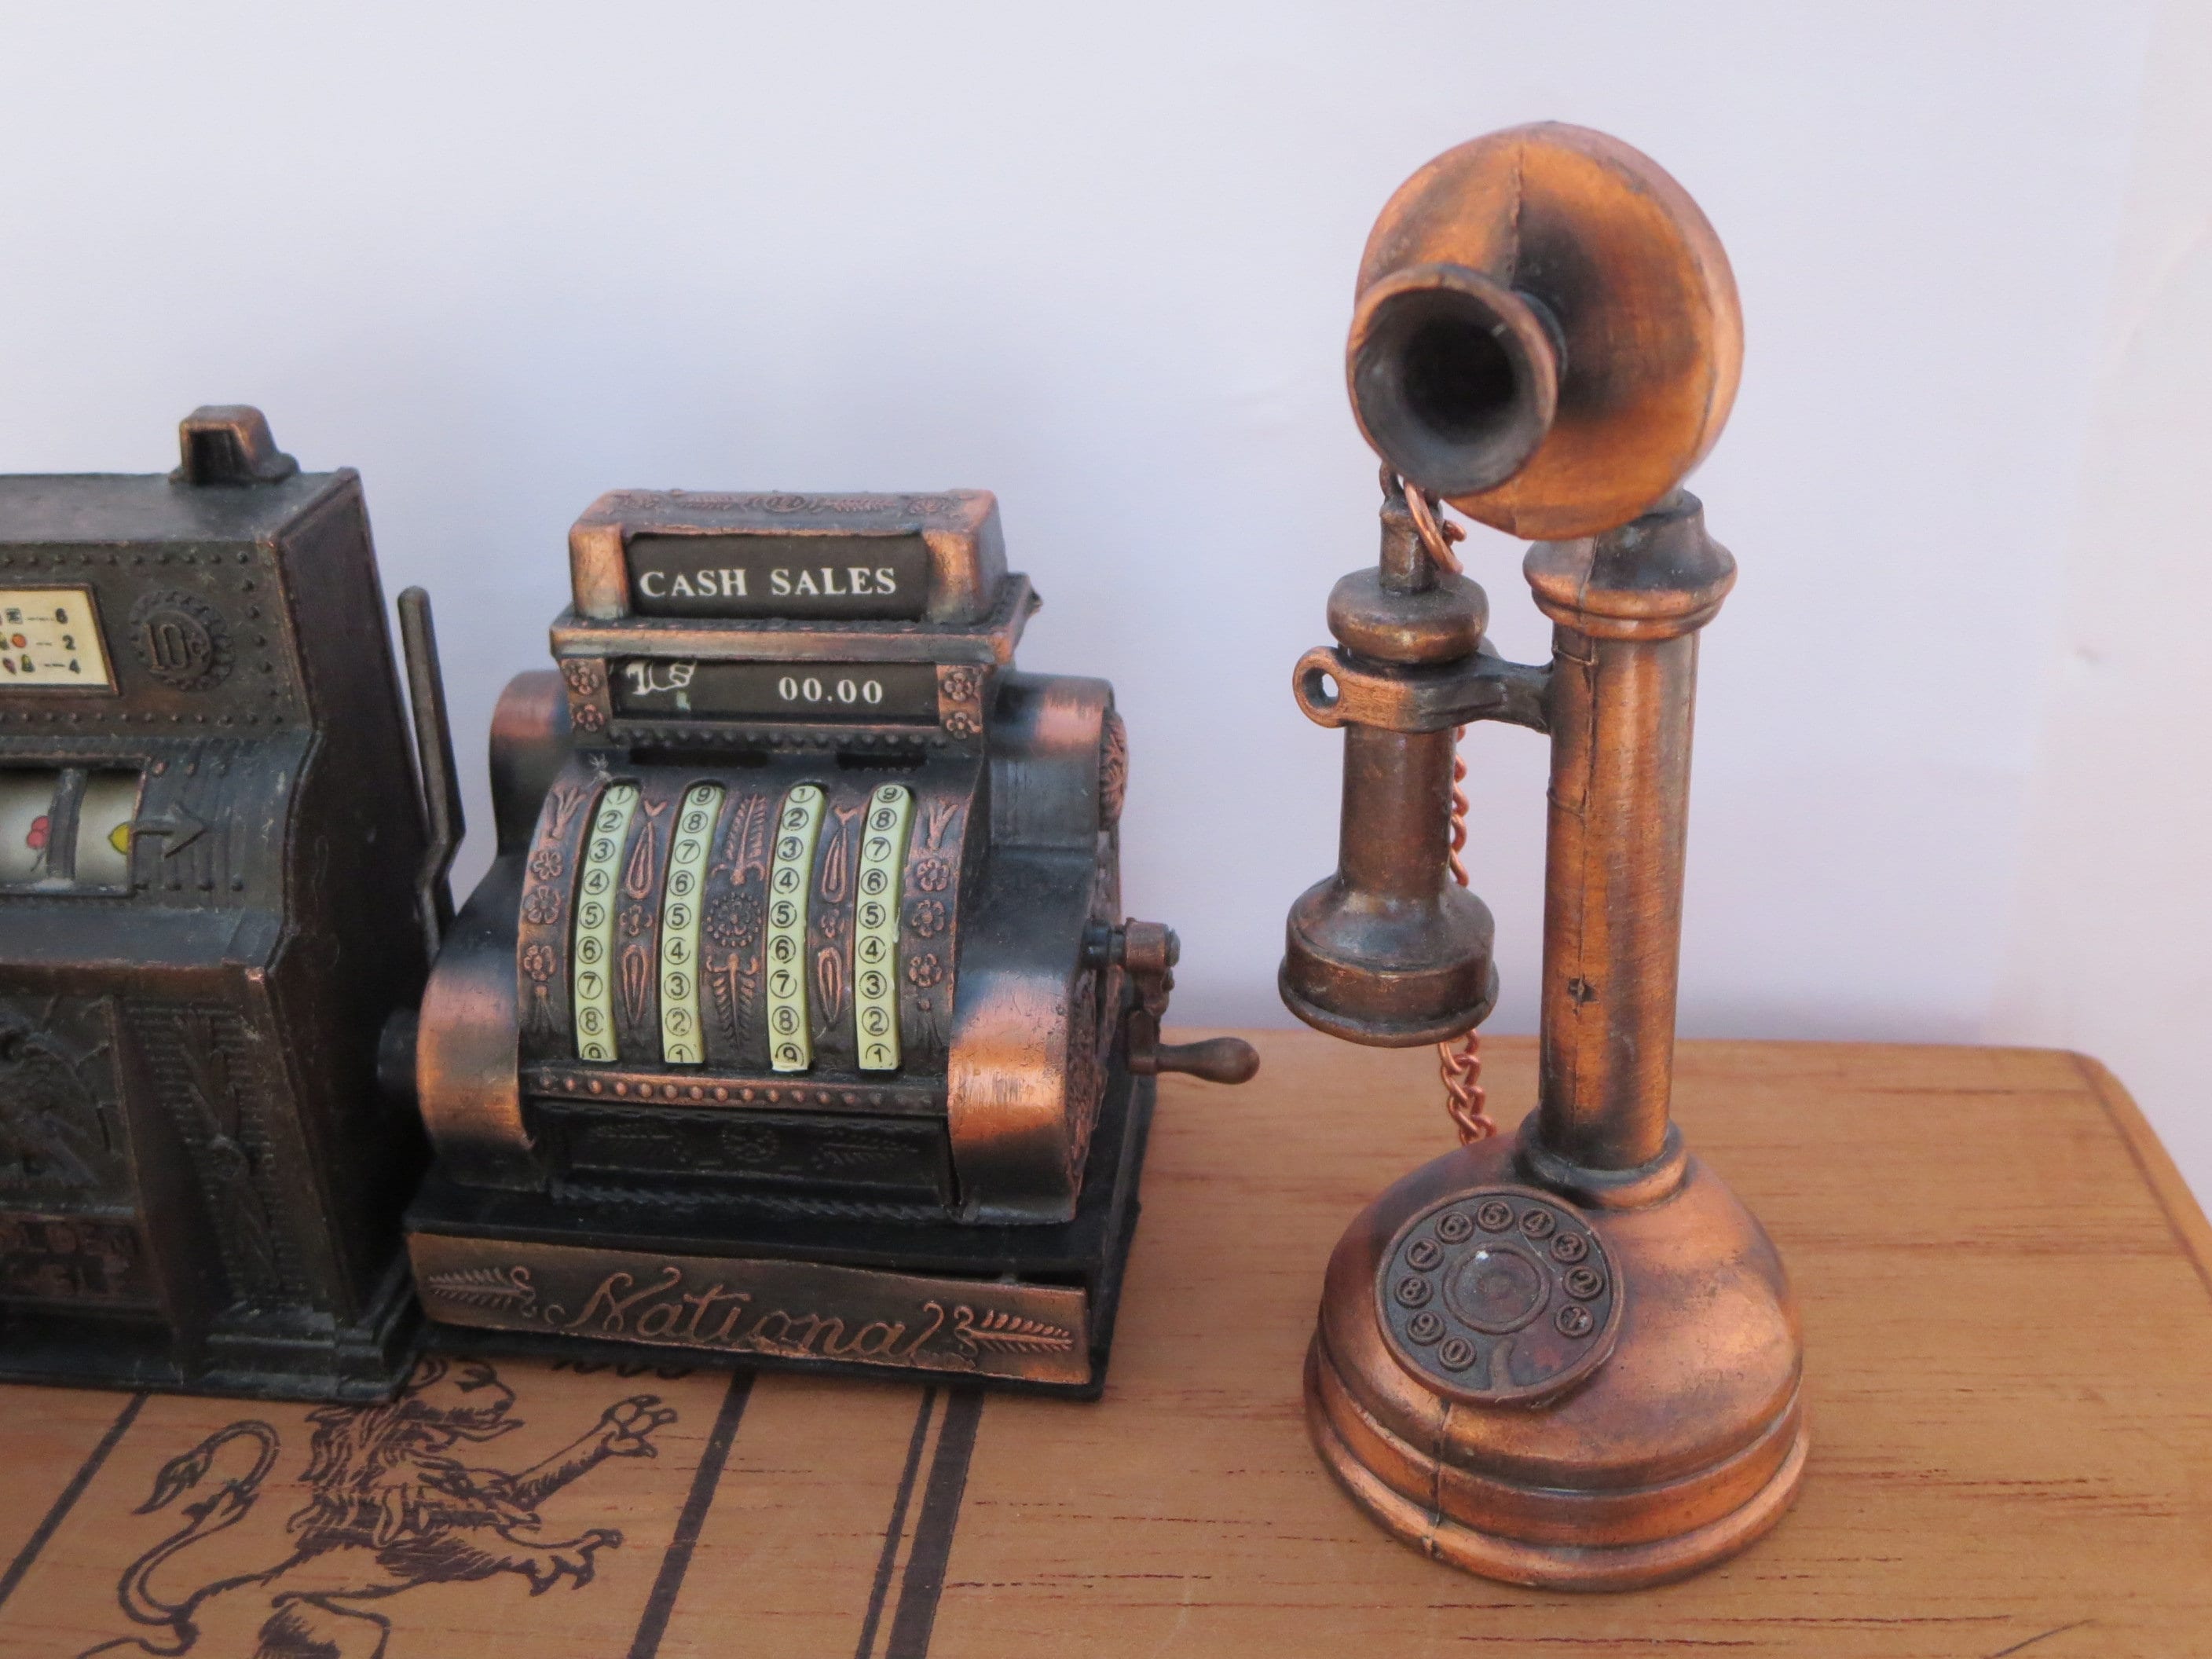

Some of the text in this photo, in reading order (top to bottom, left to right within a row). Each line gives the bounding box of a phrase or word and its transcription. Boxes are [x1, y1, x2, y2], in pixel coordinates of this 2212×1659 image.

[639, 566, 898, 599] CASH SALES
[62, 634, 76, 650] 2
[778, 676, 884, 705] 00.00
